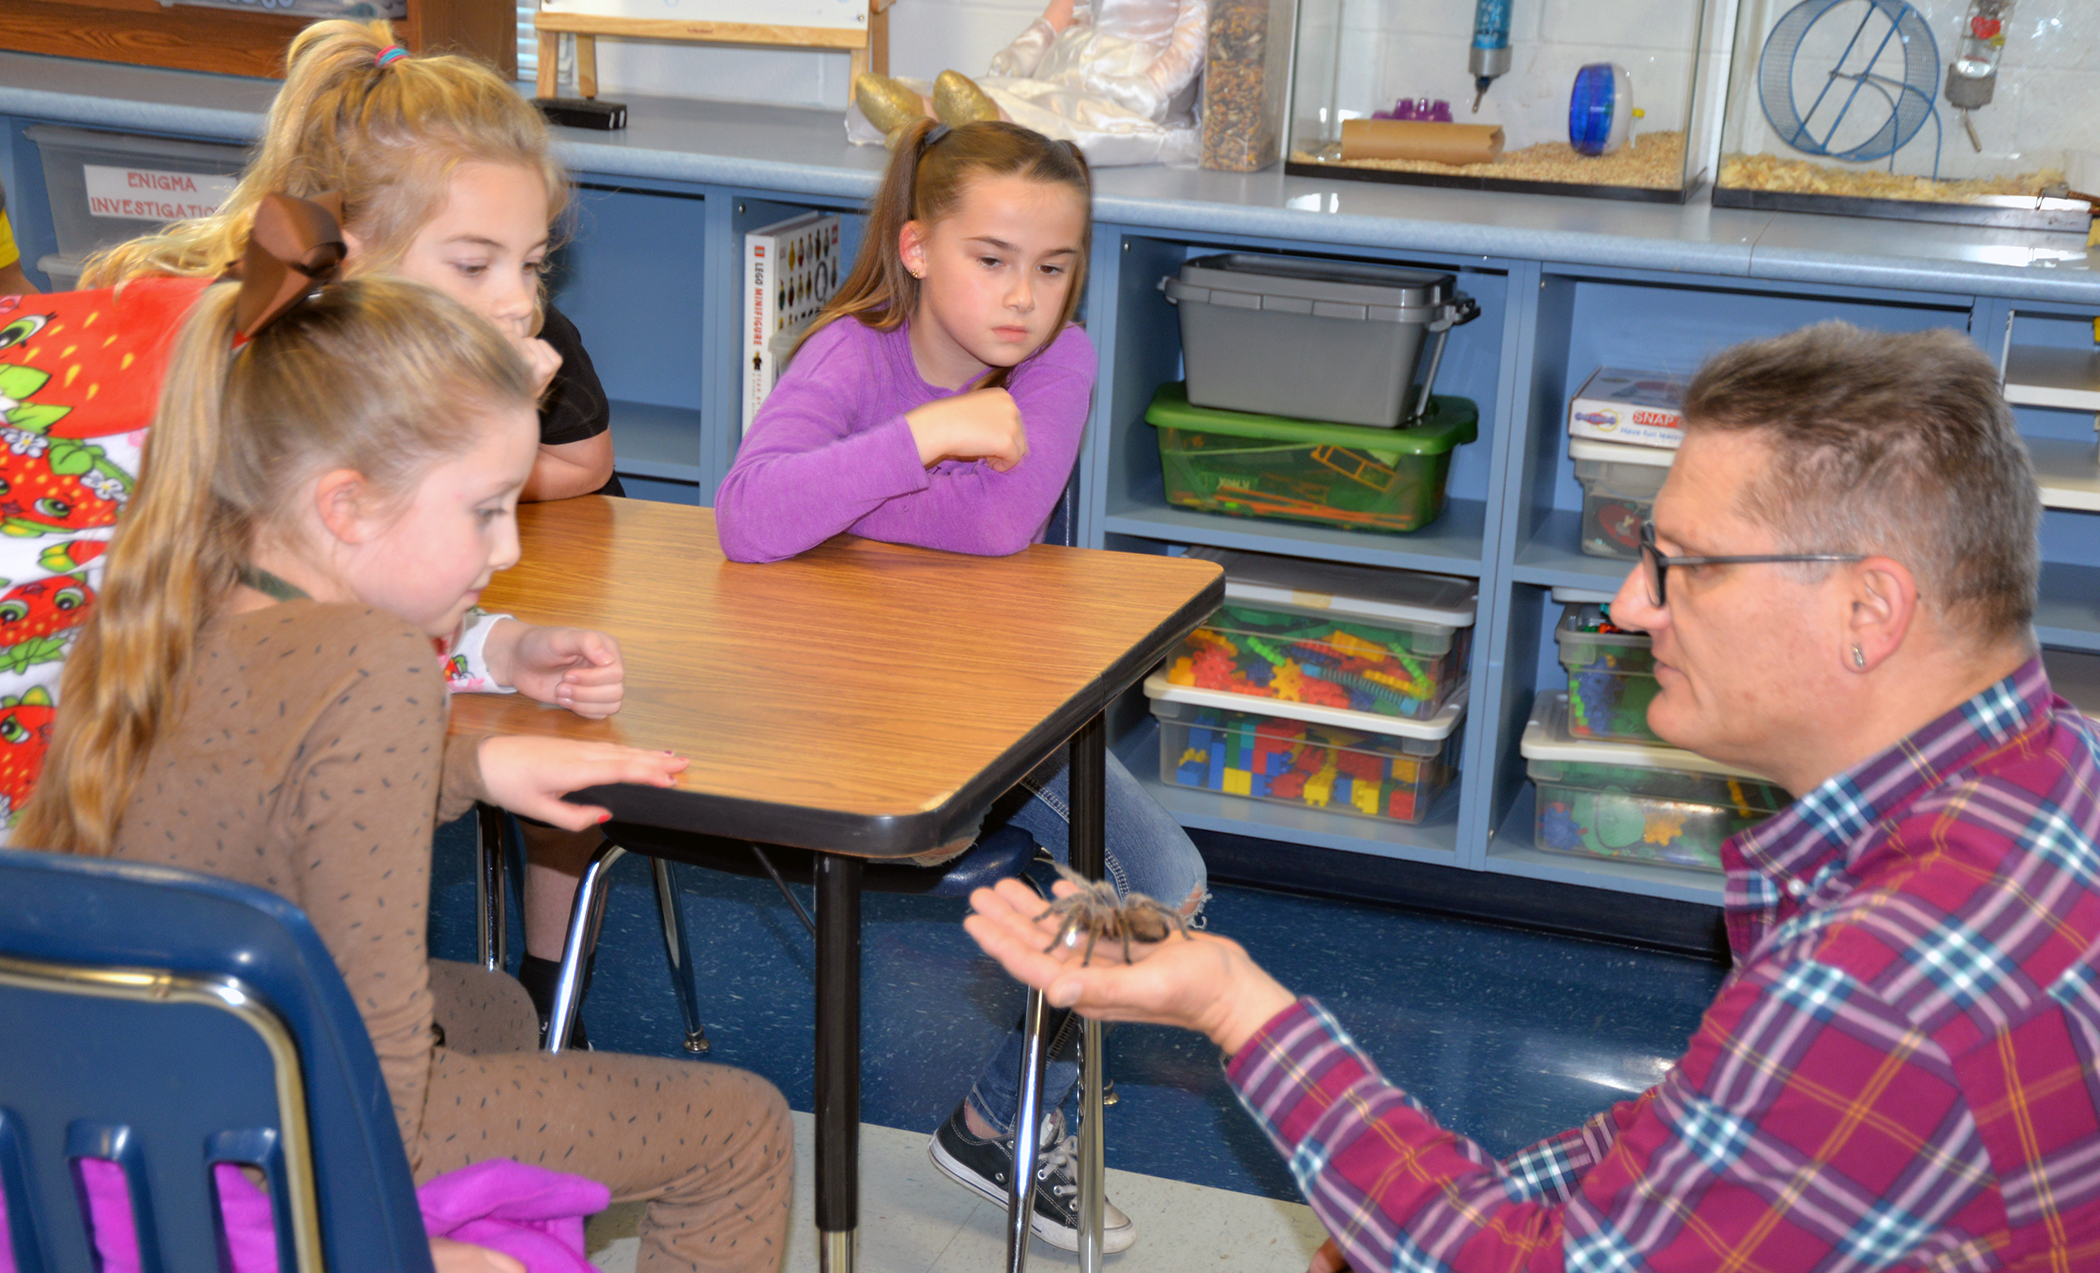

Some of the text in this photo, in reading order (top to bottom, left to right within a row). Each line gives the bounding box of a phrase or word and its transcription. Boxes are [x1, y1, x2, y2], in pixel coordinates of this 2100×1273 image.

[127, 172, 197, 192] ENIGMA
[90, 197, 219, 219] INVESTIGATIO
[754, 262, 764, 286] LEGO
[753, 287, 763, 346] MINIFIGURE
[1634, 410, 1675, 426] SNAP
[1620, 427, 1683, 441] Have fun learn
